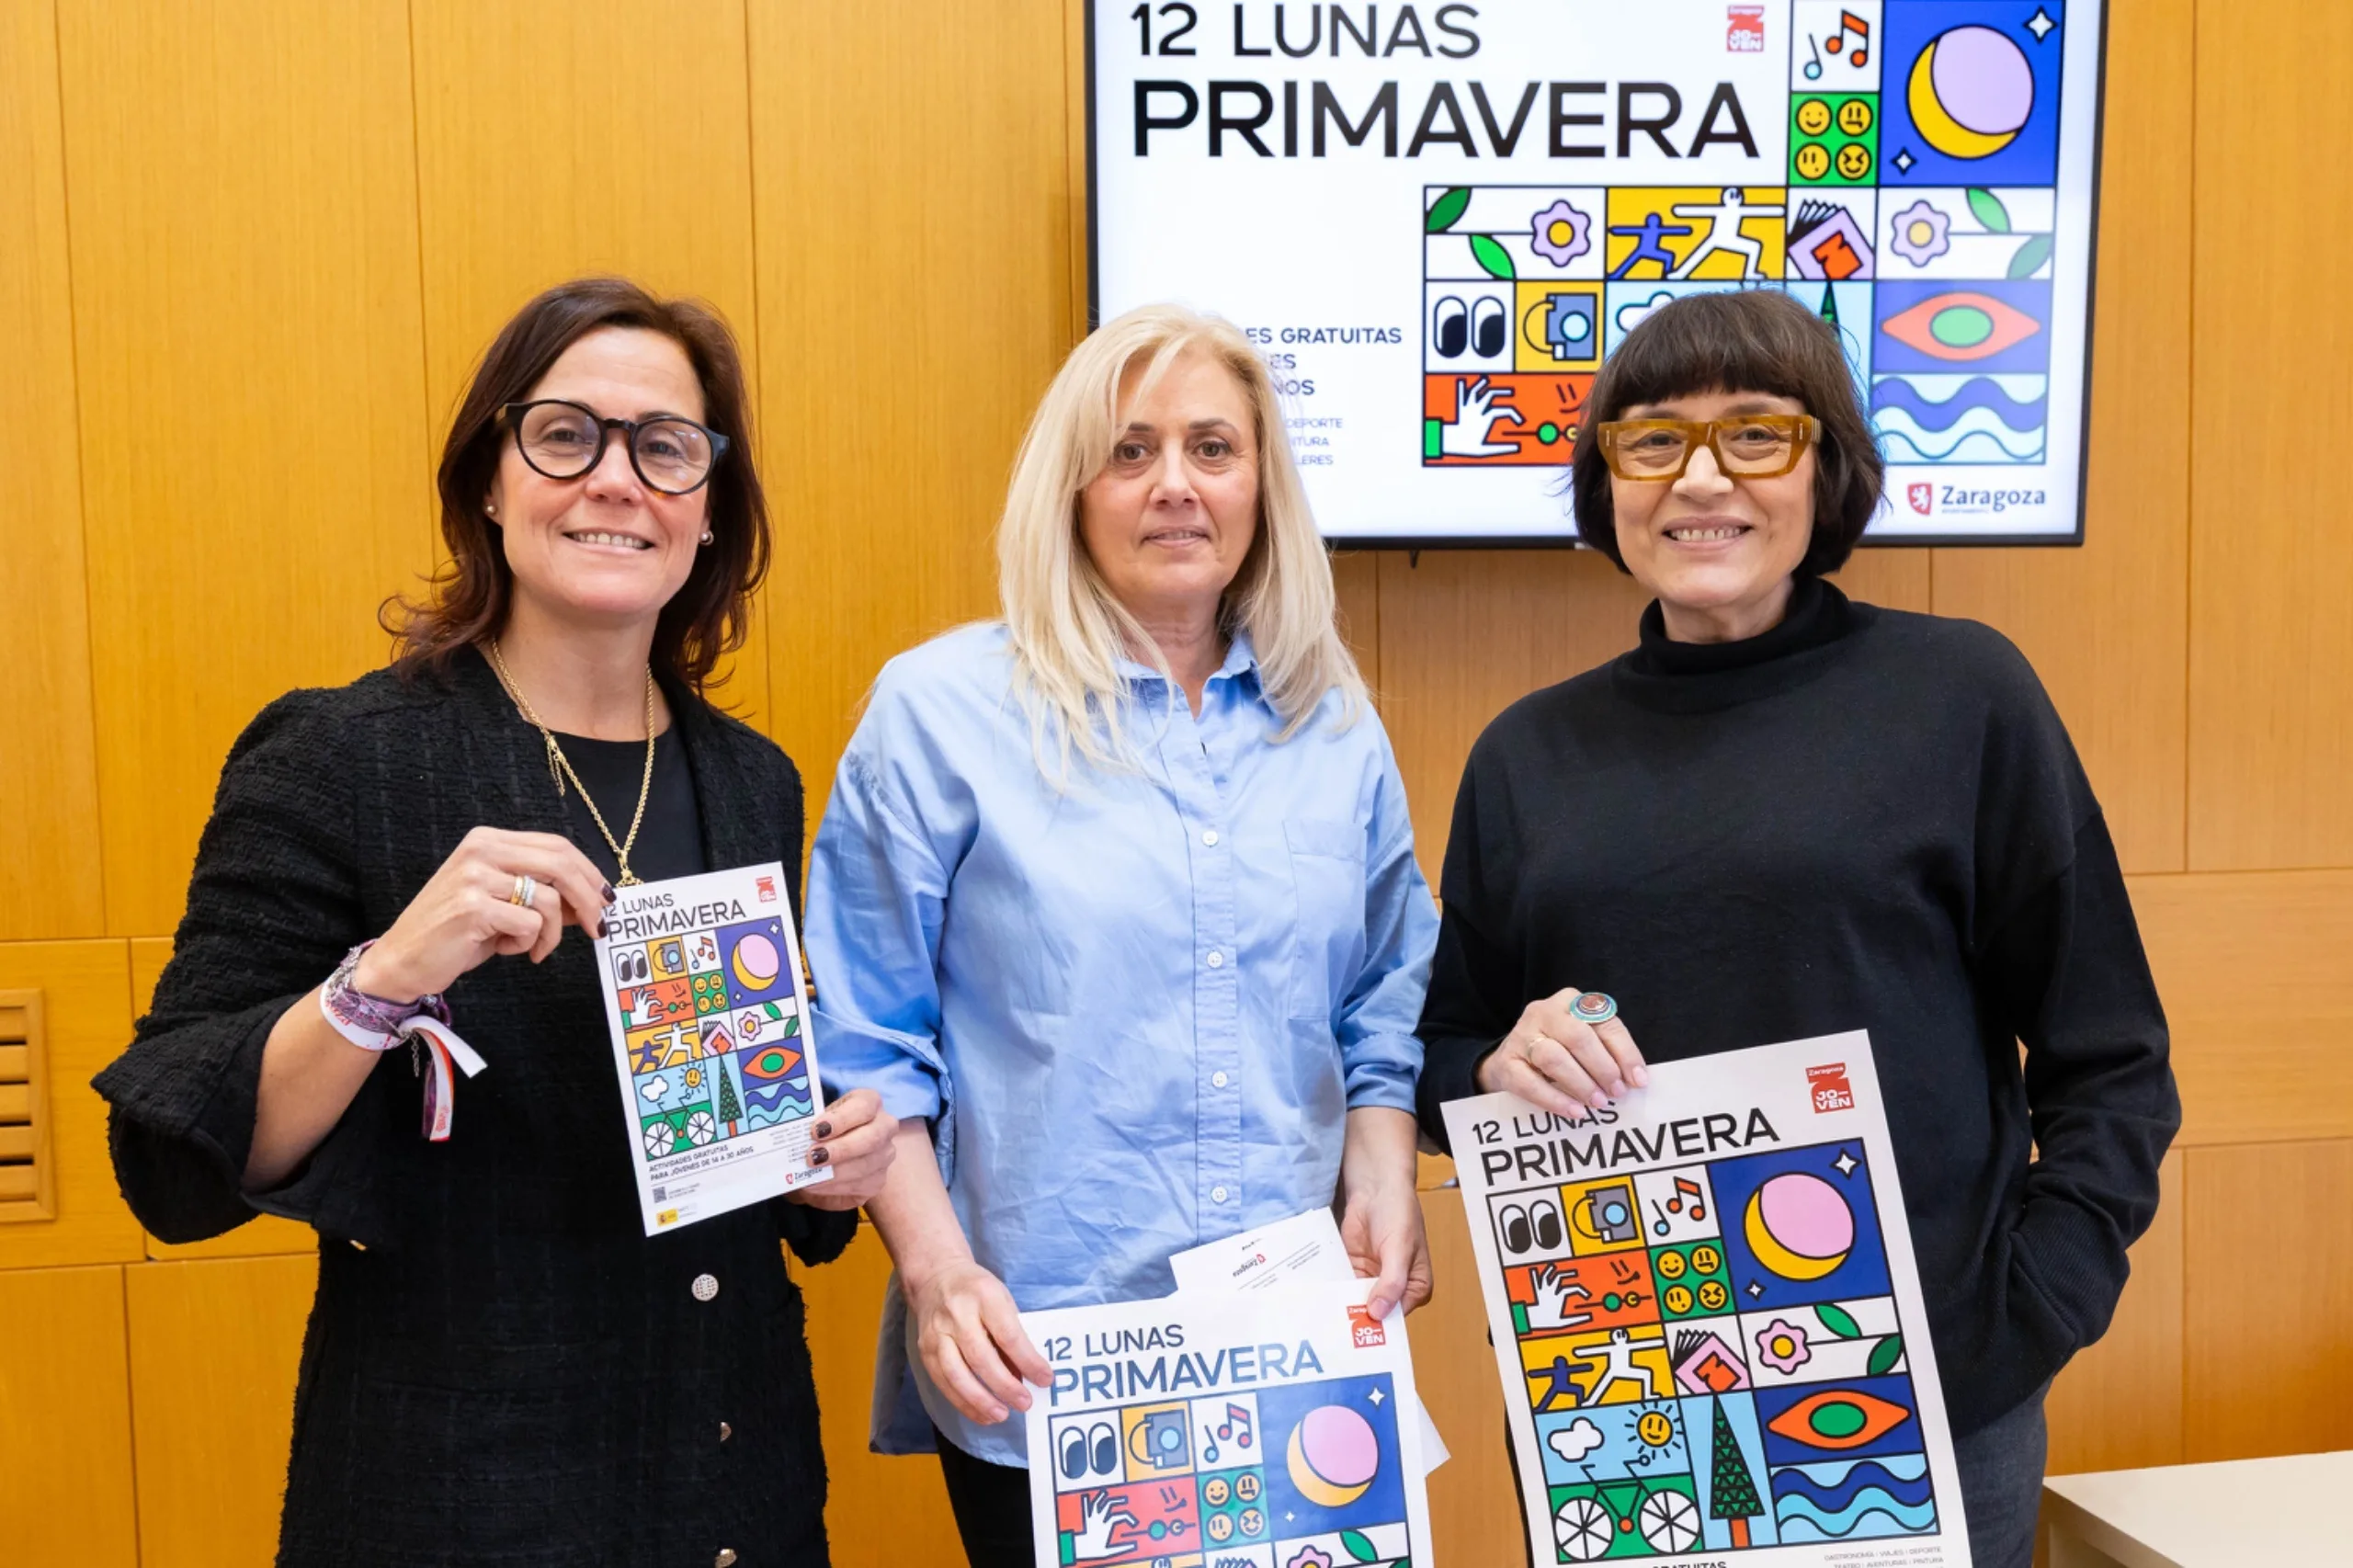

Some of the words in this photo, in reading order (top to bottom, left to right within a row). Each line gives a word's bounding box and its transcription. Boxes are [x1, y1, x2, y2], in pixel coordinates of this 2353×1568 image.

[1131, 4, 1196, 57] 12
[1233, 5, 1482, 59] LUNAS
[1133, 80, 1760, 158] PRIMAVERA
[1280, 327, 1402, 345] GRATUITAS
[1285, 417, 1343, 428] DEPORTE
[1941, 485, 2046, 512] Zaragoza
[622, 893, 675, 914] LUNAS
[607, 899, 746, 943] PRIMAVERA
[1816, 1096, 1851, 1109] VEN
[1472, 1120, 1503, 1145] 12
[1481, 1108, 1780, 1186] PRIMAVERA
[1043, 1337, 1073, 1362] 12
[1086, 1324, 1185, 1358] LUNAS
[1355, 1335, 1384, 1346] VEN
[1050, 1339, 1324, 1407] PRIMAVERA
[1909, 1546, 1941, 1555] DEPORTE
